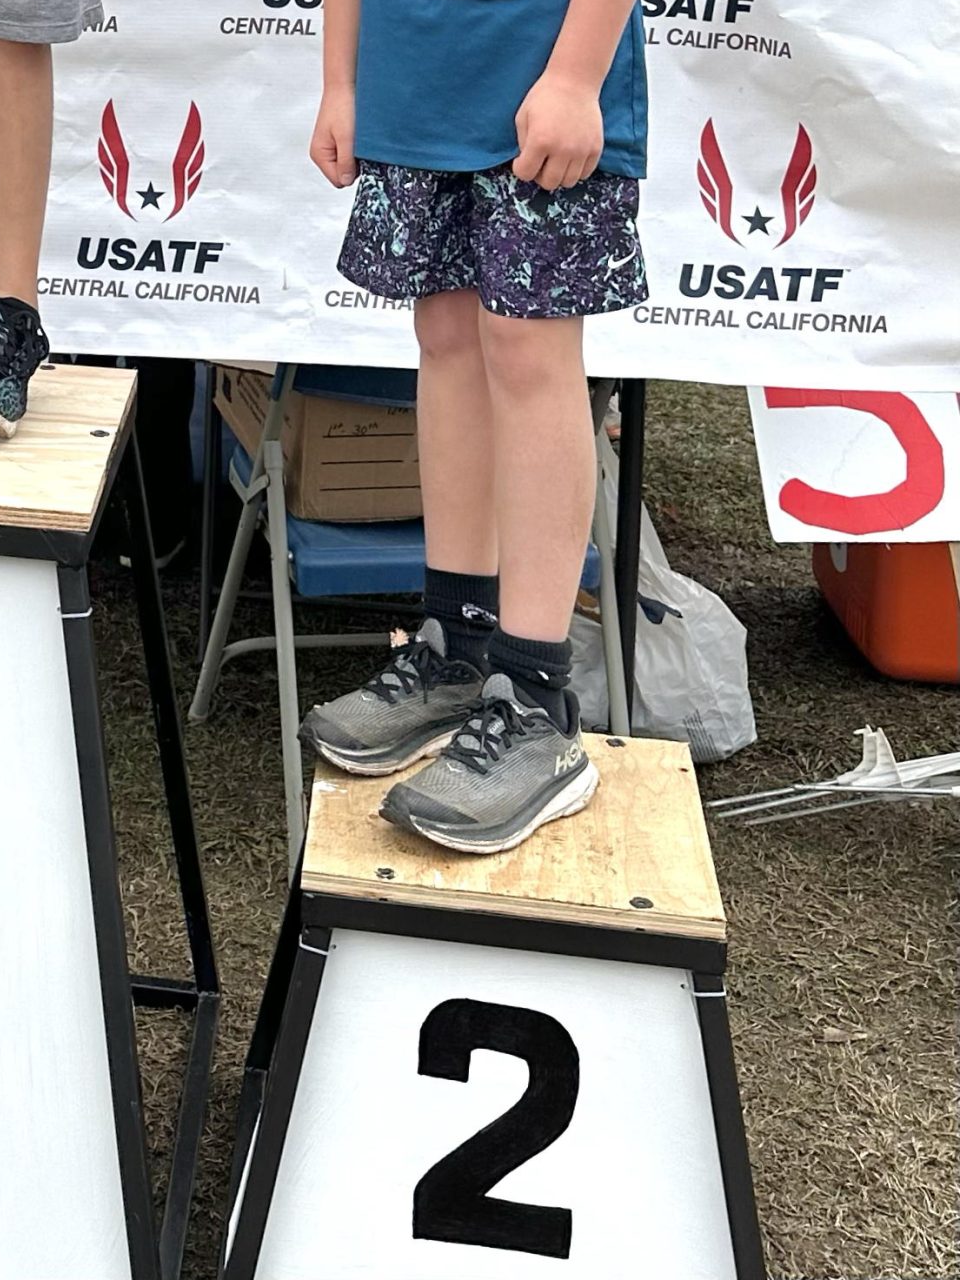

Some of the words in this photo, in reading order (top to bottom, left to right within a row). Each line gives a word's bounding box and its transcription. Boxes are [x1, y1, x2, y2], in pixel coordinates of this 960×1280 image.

[220, 17, 317, 36] CENTRAL
[667, 28, 792, 59] CALIFORNIA
[77, 237, 224, 273] USATF
[37, 277, 129, 298] CENTRAL
[135, 281, 261, 304] CALIFORNIA
[678, 263, 845, 303] USATF
[633, 306, 739, 331] CENTRAL
[746, 311, 888, 335] CALIFORNIA
[411, 997, 581, 1261] 2
